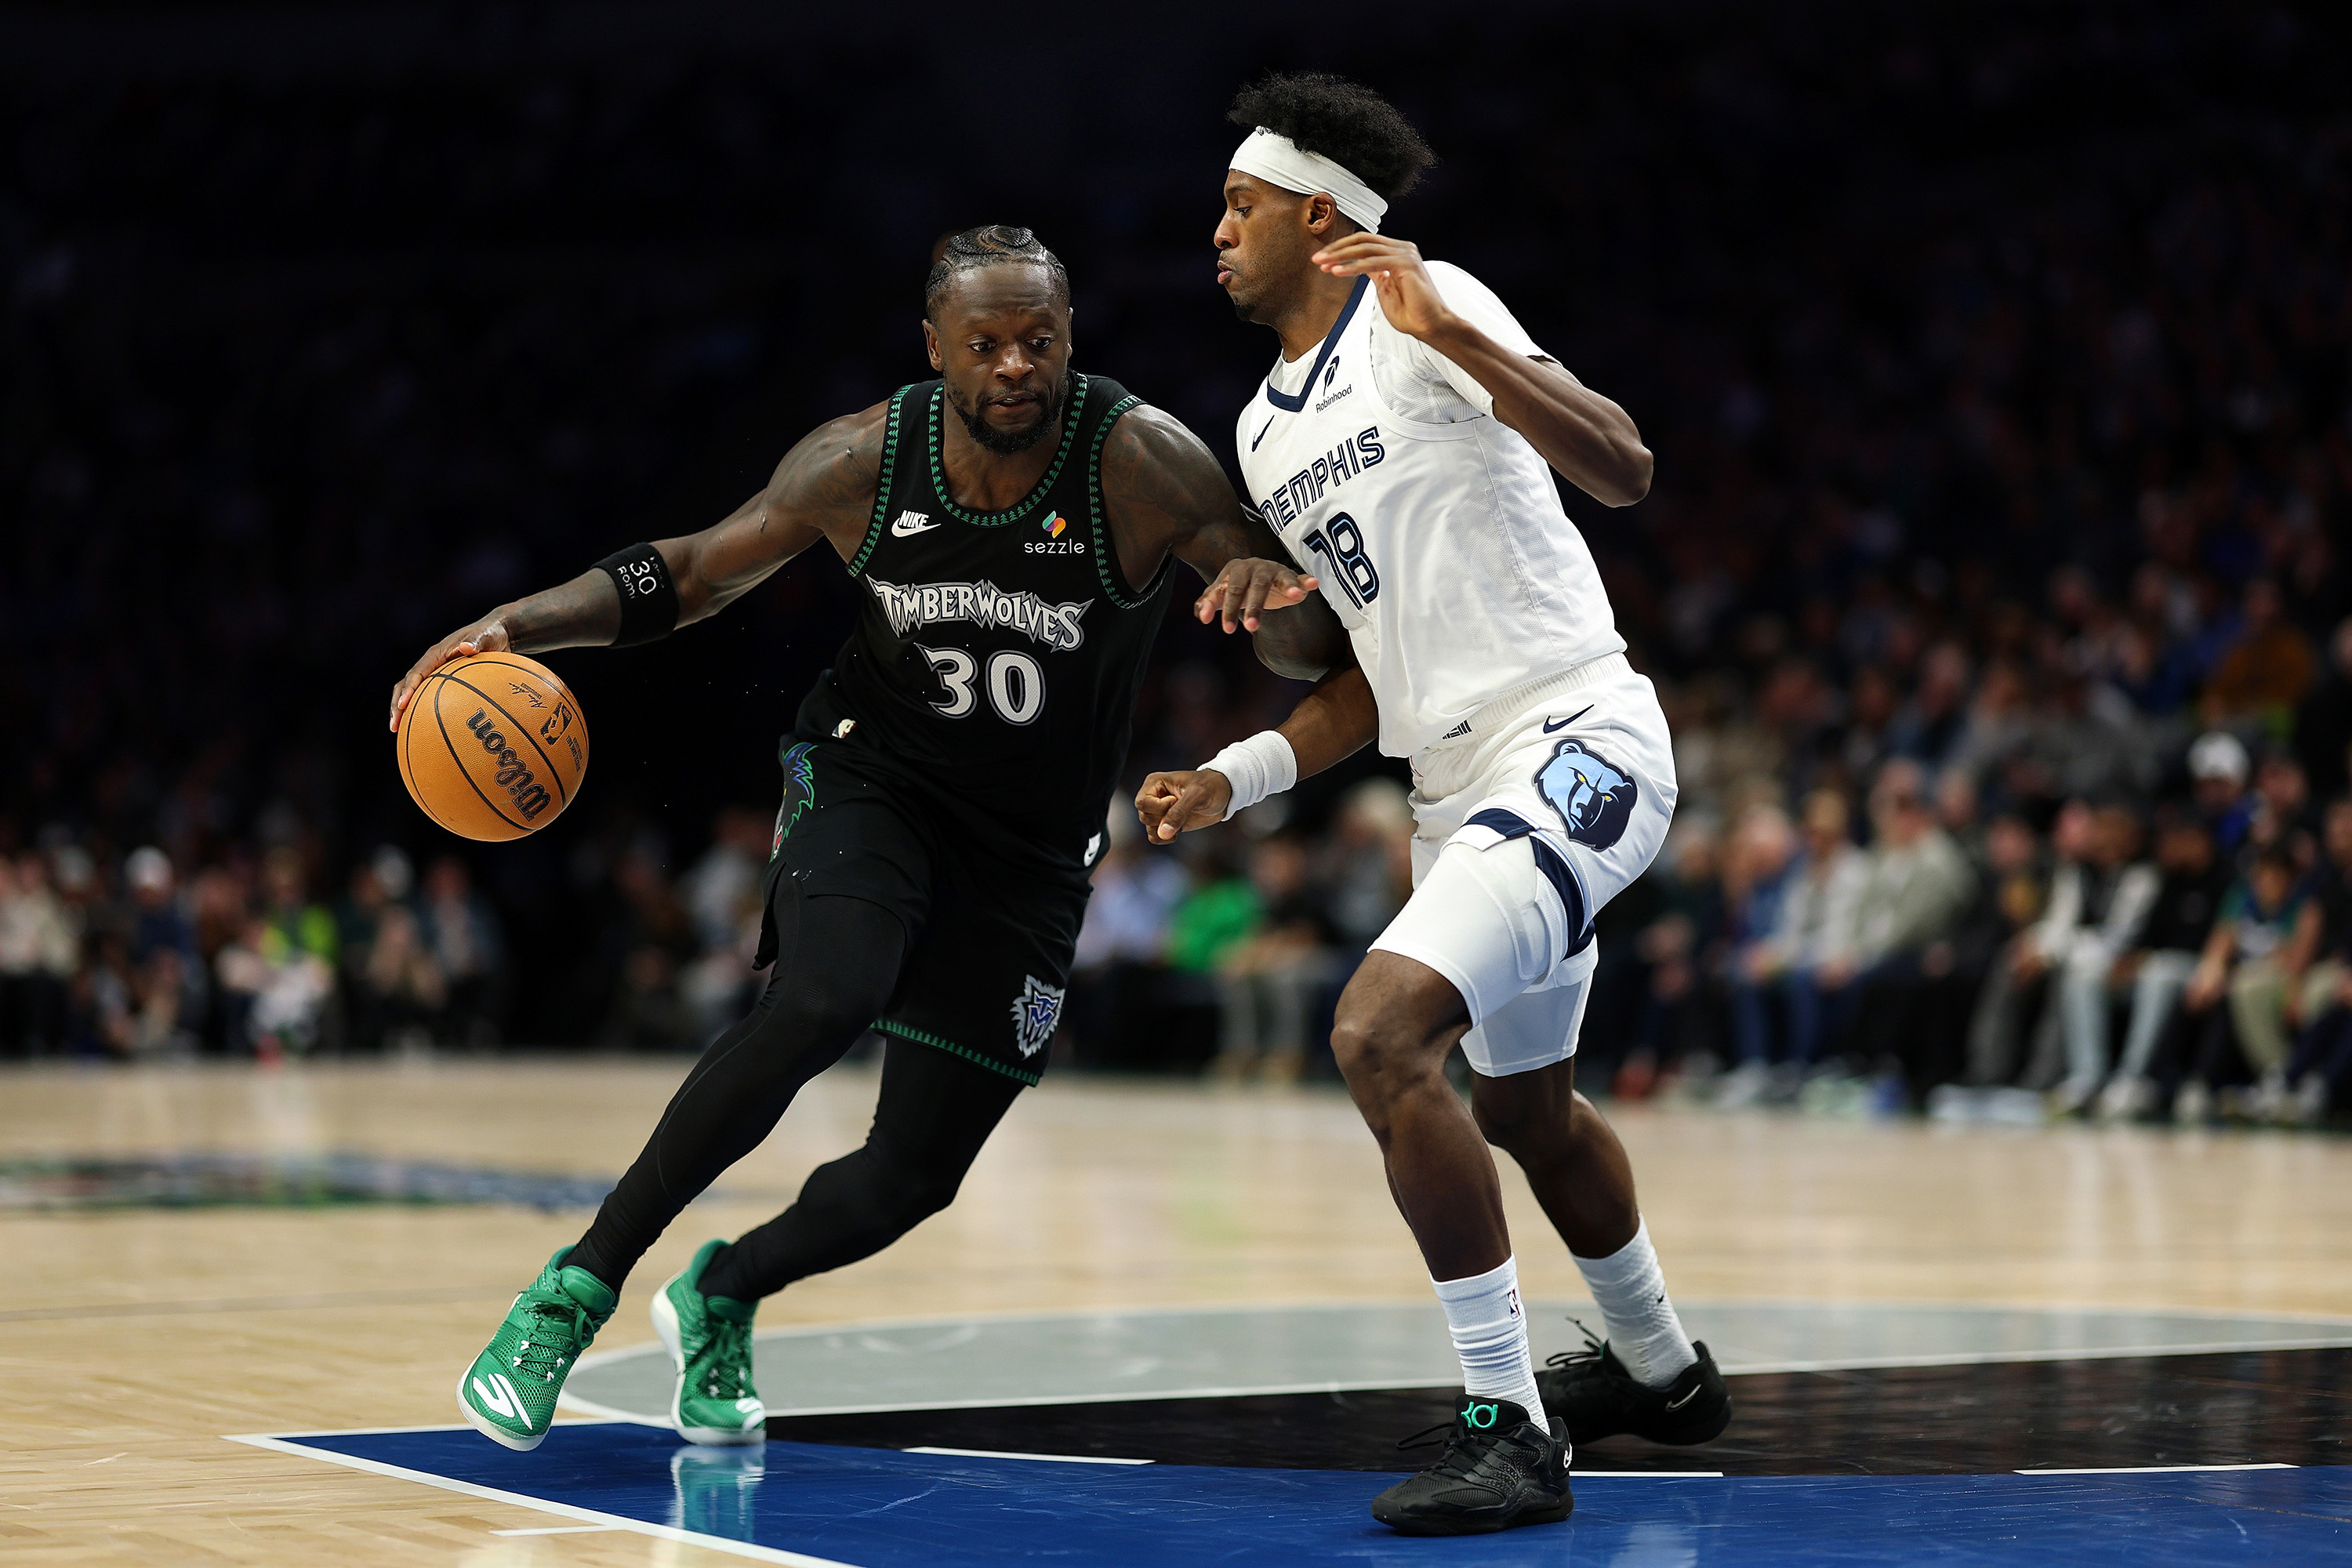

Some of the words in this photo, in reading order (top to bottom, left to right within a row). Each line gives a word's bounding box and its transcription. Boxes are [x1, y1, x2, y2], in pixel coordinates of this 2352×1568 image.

[1316, 383, 1352, 414] Robinhood
[898, 510, 929, 528] NIKE
[1024, 539, 1085, 554] sezzle
[629, 561, 657, 595] 30
[1301, 511, 1380, 611] 18
[865, 573, 1095, 653] TIMBERWOLVES
[913, 642, 1047, 726] 30
[466, 707, 552, 822] Wilson
